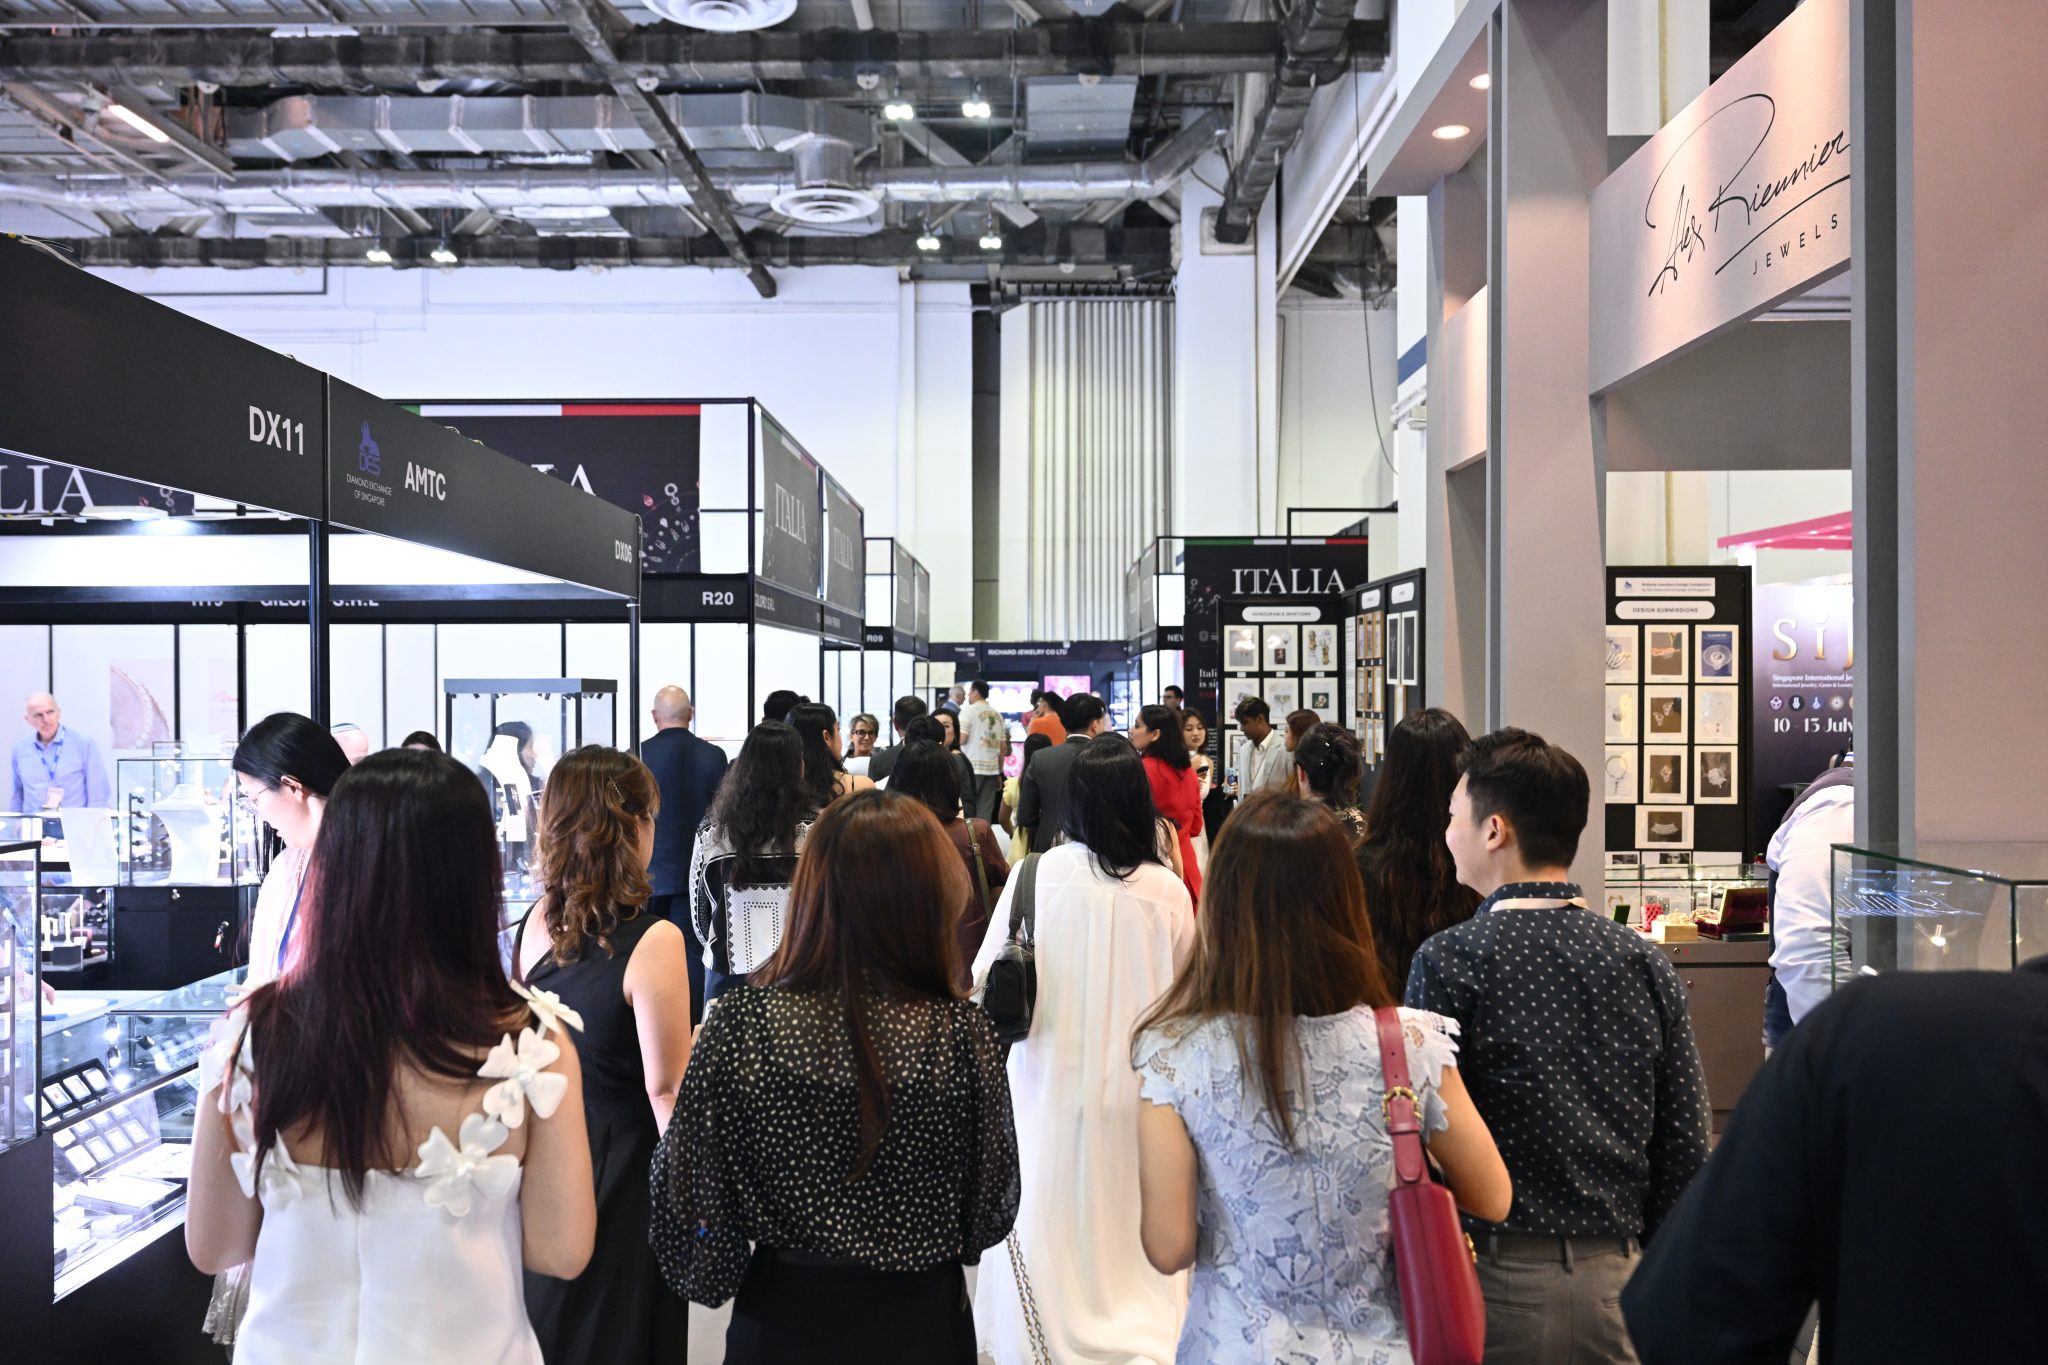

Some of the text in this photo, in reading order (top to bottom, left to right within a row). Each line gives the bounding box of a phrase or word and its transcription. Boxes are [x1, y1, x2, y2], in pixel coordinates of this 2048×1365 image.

[1648, 184, 1705, 297] Alex
[1752, 213, 1839, 276] JEWELS
[249, 404, 304, 456] DX11
[346, 473, 392, 496] DIAMOND EXCHANGE
[404, 461, 446, 501] AMTC
[360, 491, 386, 507] SINGAPORE
[775, 482, 807, 545] ITALIA
[615, 539, 633, 563] DX06
[1231, 567, 1346, 595] ITALIA
[701, 591, 734, 606] R20
[866, 633, 884, 644] R09
[988, 648, 1068, 656] RICHARD JEWELRY CO LTD
[1772, 673, 1804, 683] Singapore
[1804, 673, 1845, 682] International
[1774, 717, 1791, 733] 10
